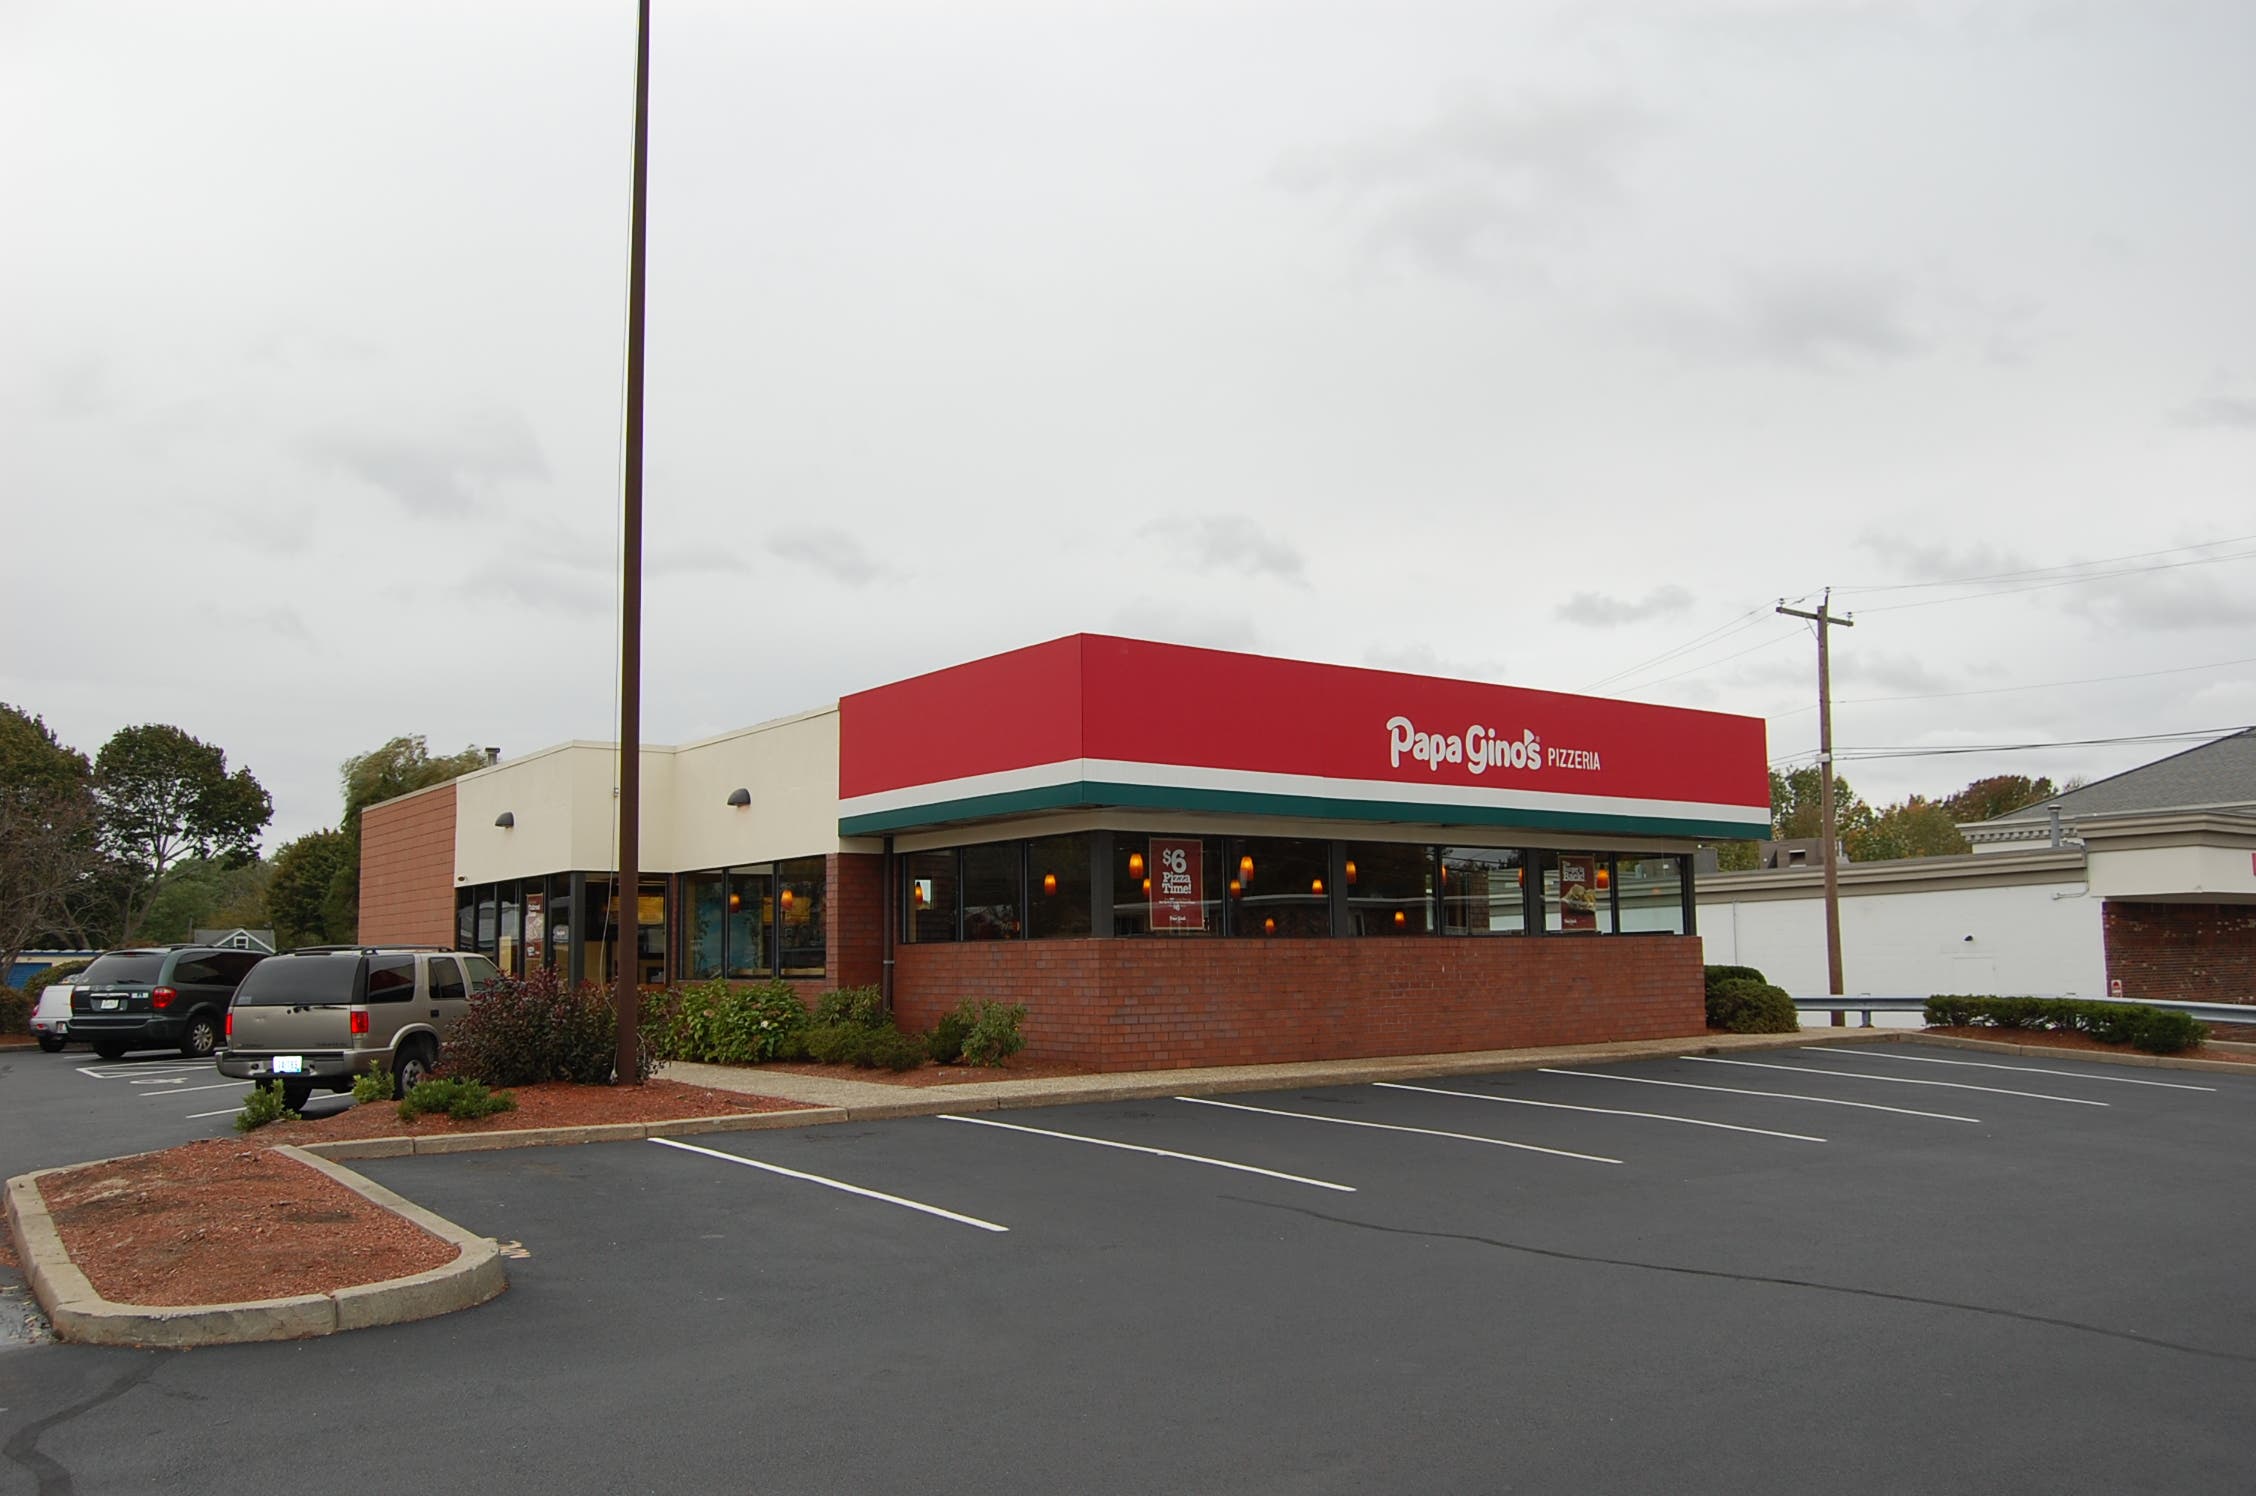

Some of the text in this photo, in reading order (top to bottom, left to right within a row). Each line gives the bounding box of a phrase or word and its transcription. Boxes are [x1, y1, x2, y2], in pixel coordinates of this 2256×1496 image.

[1386, 716, 1601, 774] Papa Gino's PIZZERIA
[1162, 848, 1187, 873] $6
[1162, 871, 1191, 883] Pizza
[1162, 882, 1191, 894] Time!
